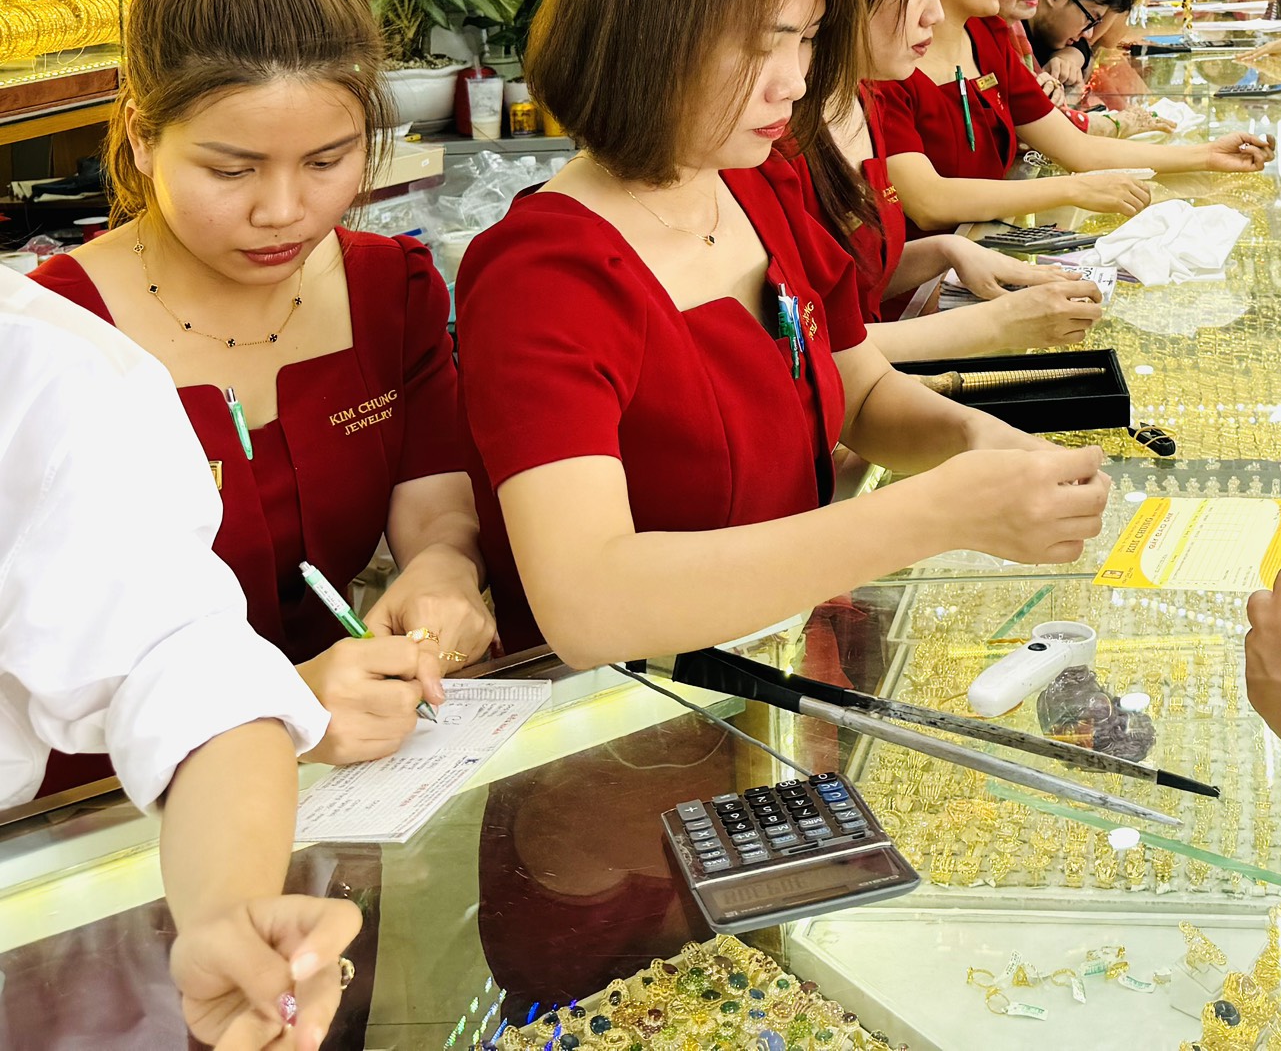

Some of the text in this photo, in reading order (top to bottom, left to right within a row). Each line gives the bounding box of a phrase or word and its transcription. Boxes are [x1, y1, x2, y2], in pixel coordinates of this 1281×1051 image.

[329, 389, 398, 426] KIM CHUNG
[344, 407, 393, 436] JEWELRY
